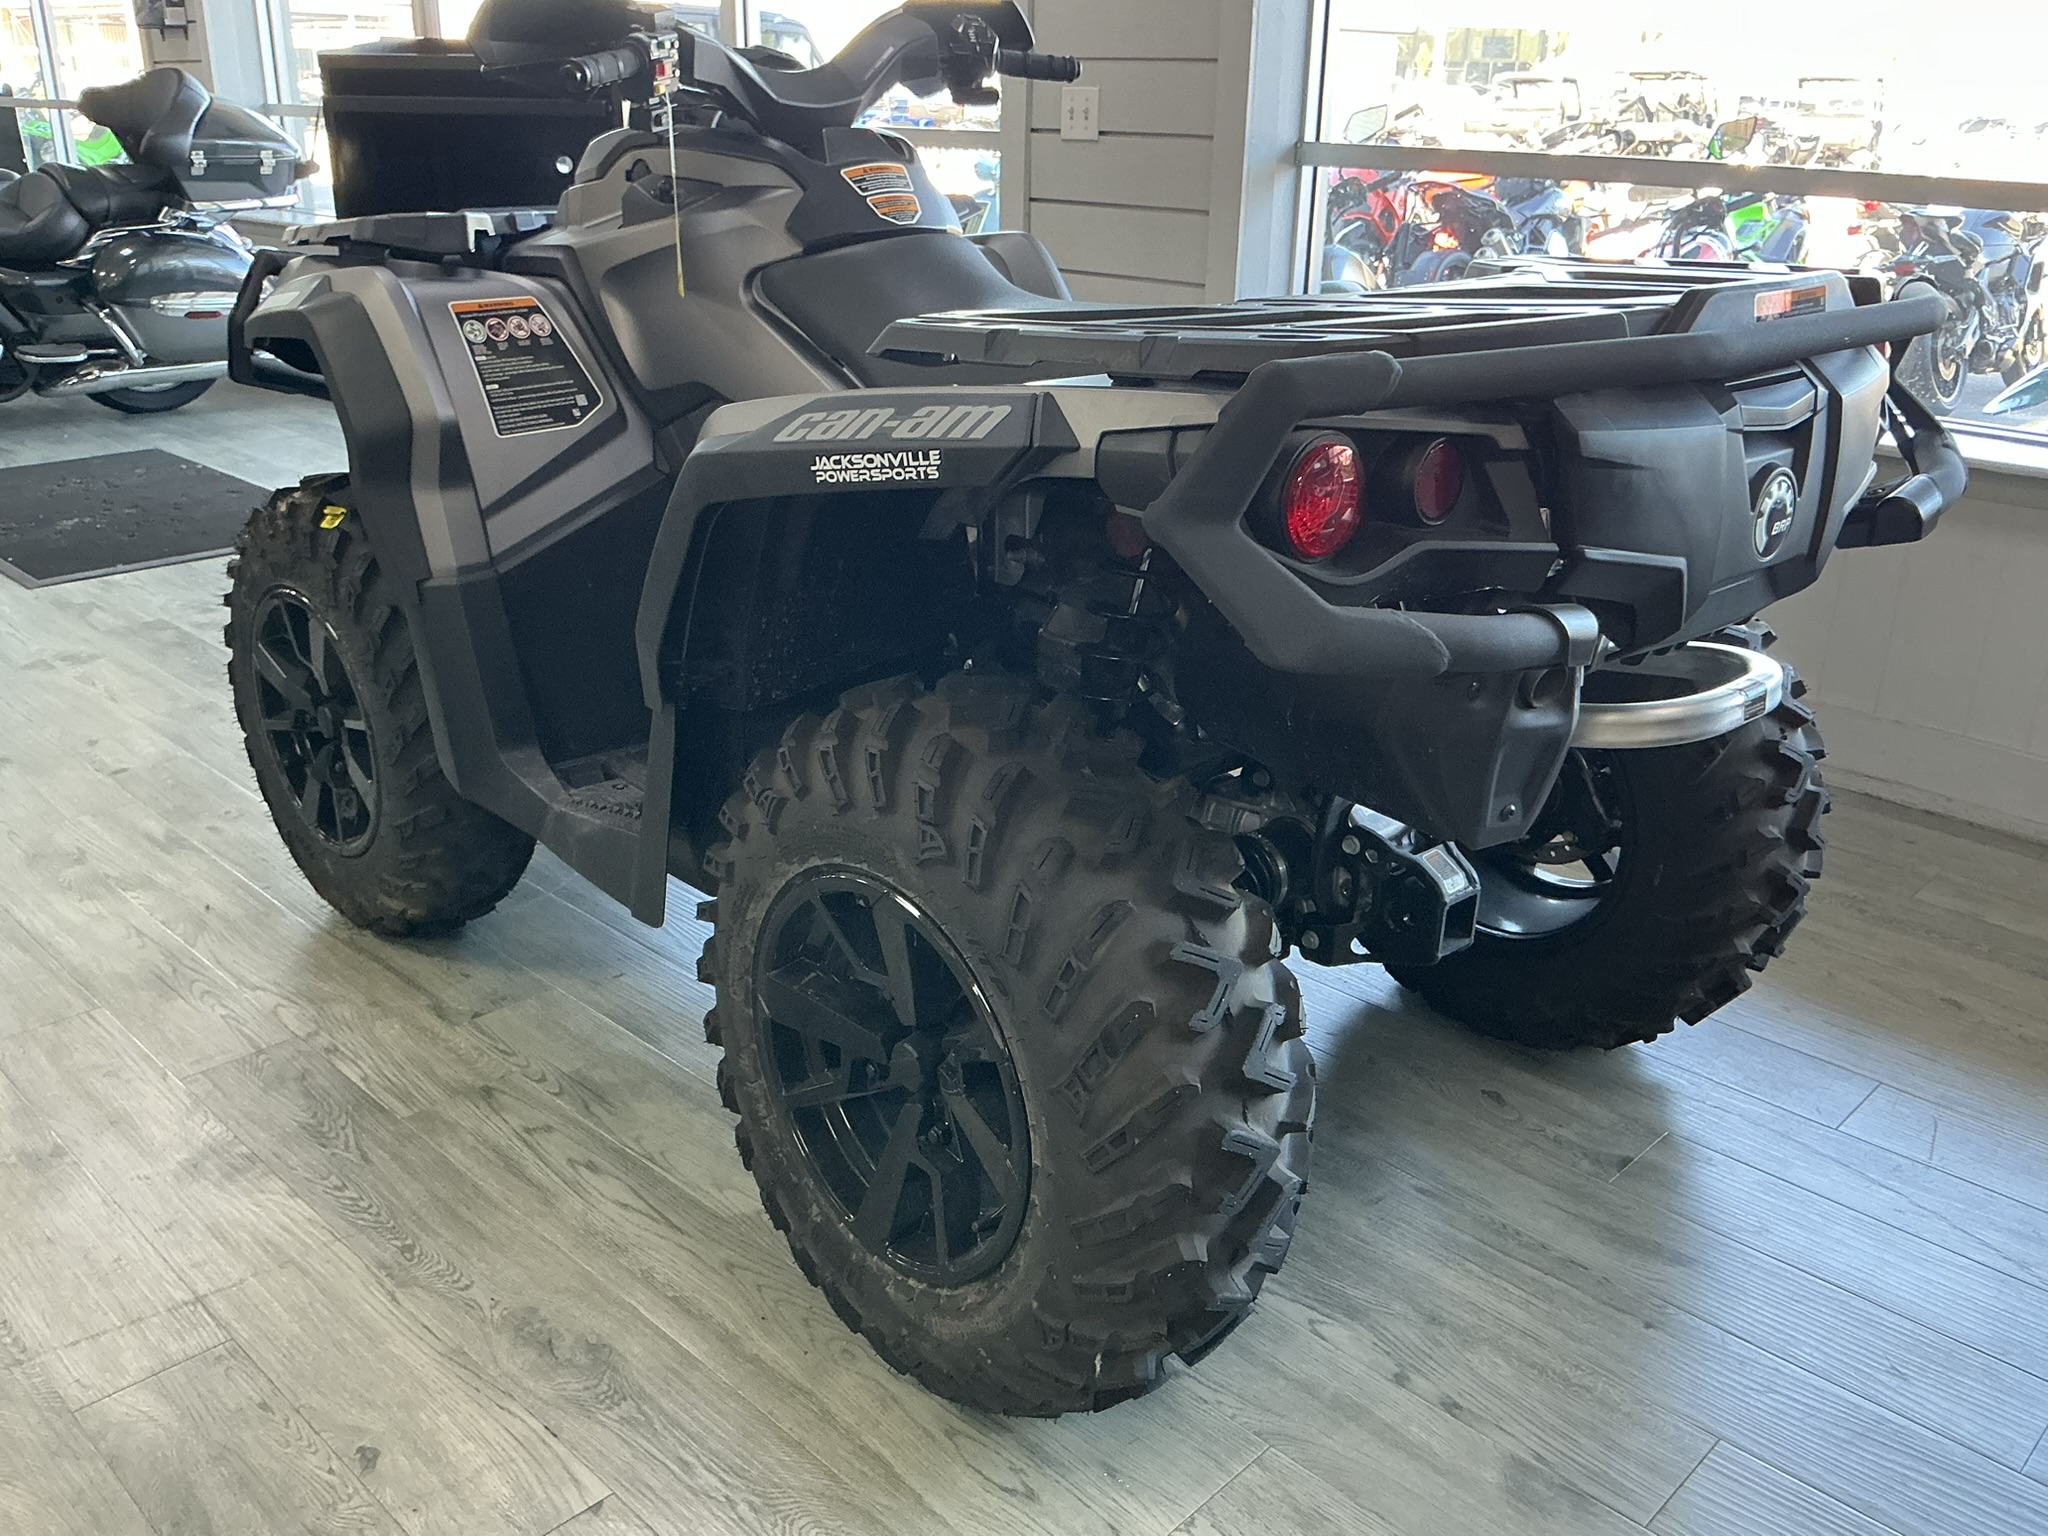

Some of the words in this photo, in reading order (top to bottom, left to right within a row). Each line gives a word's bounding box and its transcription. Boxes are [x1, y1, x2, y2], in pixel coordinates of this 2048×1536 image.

[773, 405, 1011, 442] can-am
[811, 450, 941, 470] JACKSONVILLE
[816, 467, 940, 483] POWERSPORTS
[1771, 518, 1791, 535] BRP
